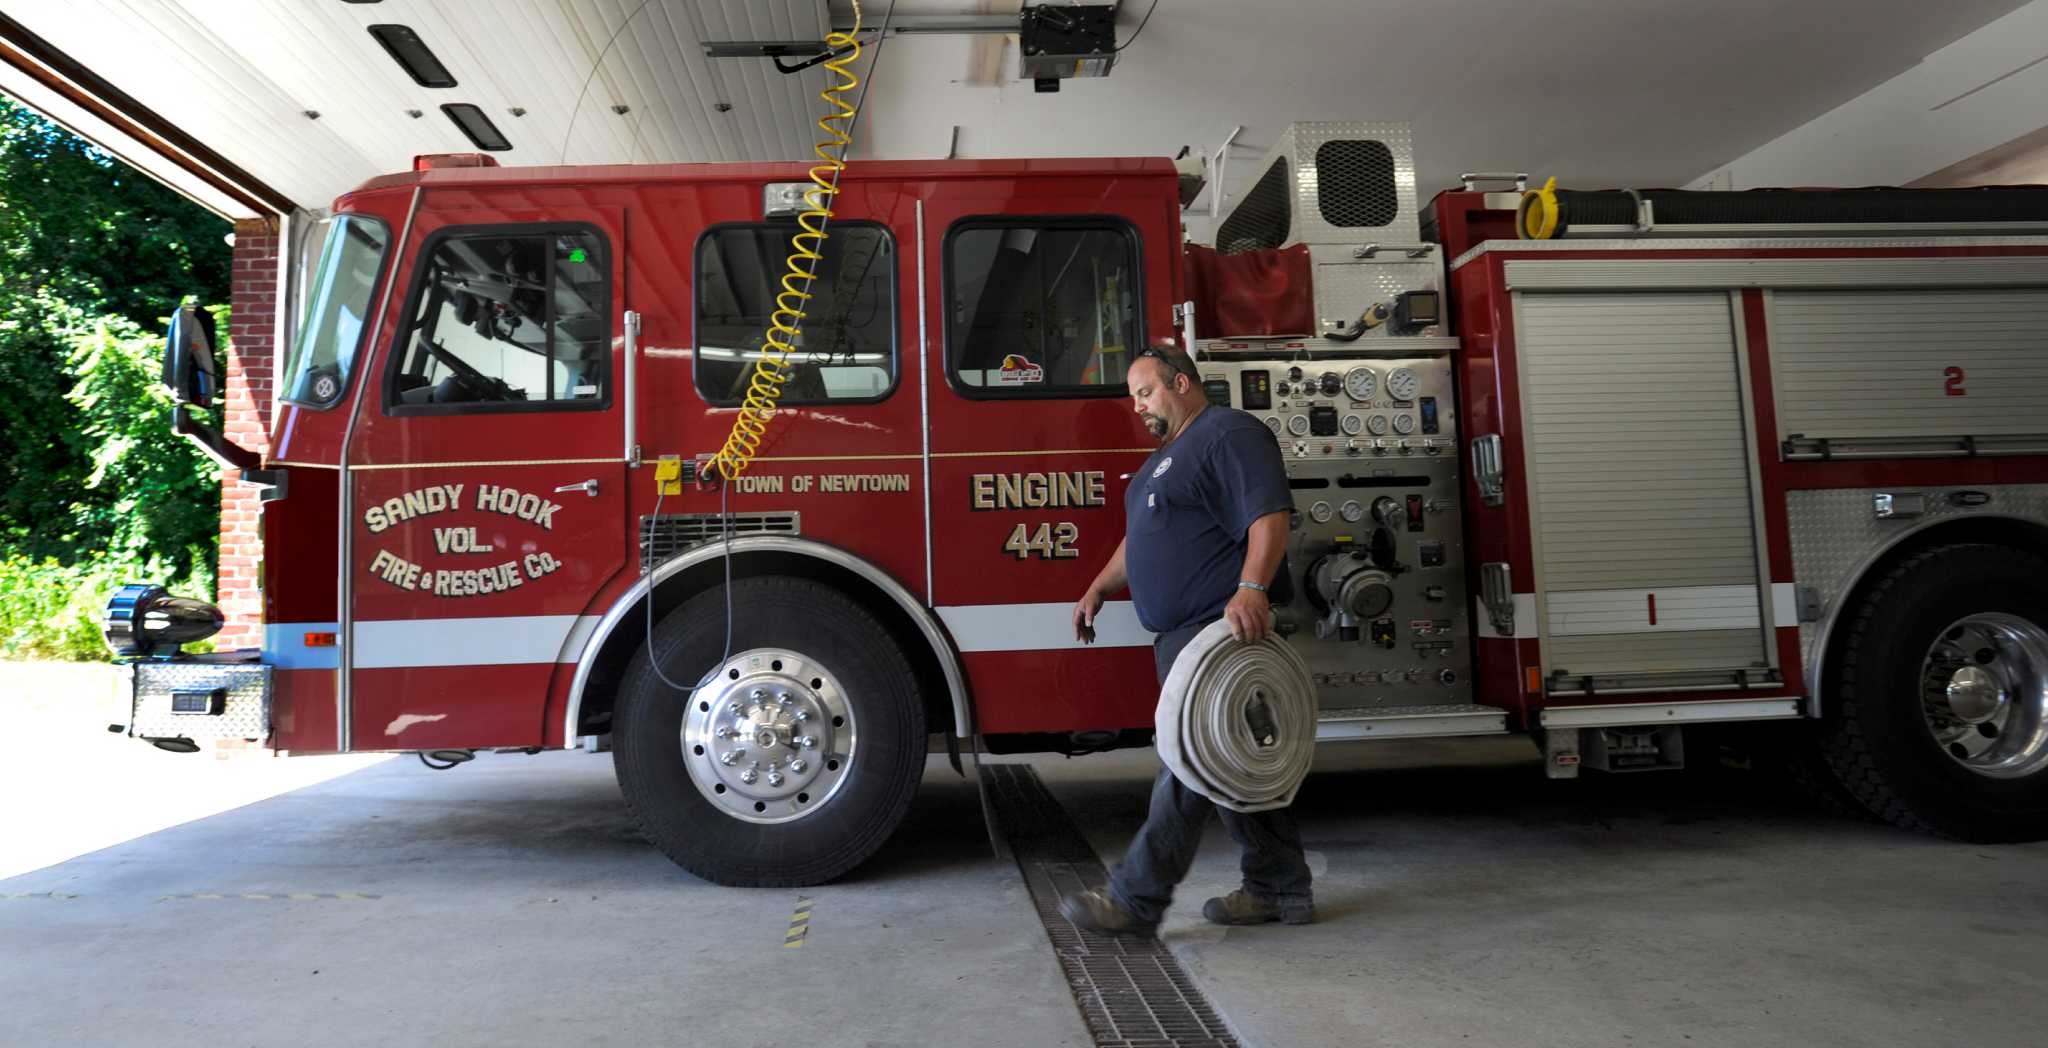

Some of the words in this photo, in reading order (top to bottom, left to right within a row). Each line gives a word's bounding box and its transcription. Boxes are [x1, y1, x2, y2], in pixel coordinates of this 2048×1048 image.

[1943, 366, 1967, 396] 2
[735, 475, 783, 493] TOWN
[791, 475, 813, 493] OF
[820, 474, 909, 492] NEWTOWN
[971, 471, 1106, 509] ENGINE
[364, 484, 464, 533] SANDY
[476, 484, 563, 530] HOOK
[433, 527, 493, 554] VOL.
[1004, 522, 1080, 559] 442
[369, 549, 422, 591] FIRE
[420, 572, 432, 590] &
[433, 561, 523, 596] RESCUE
